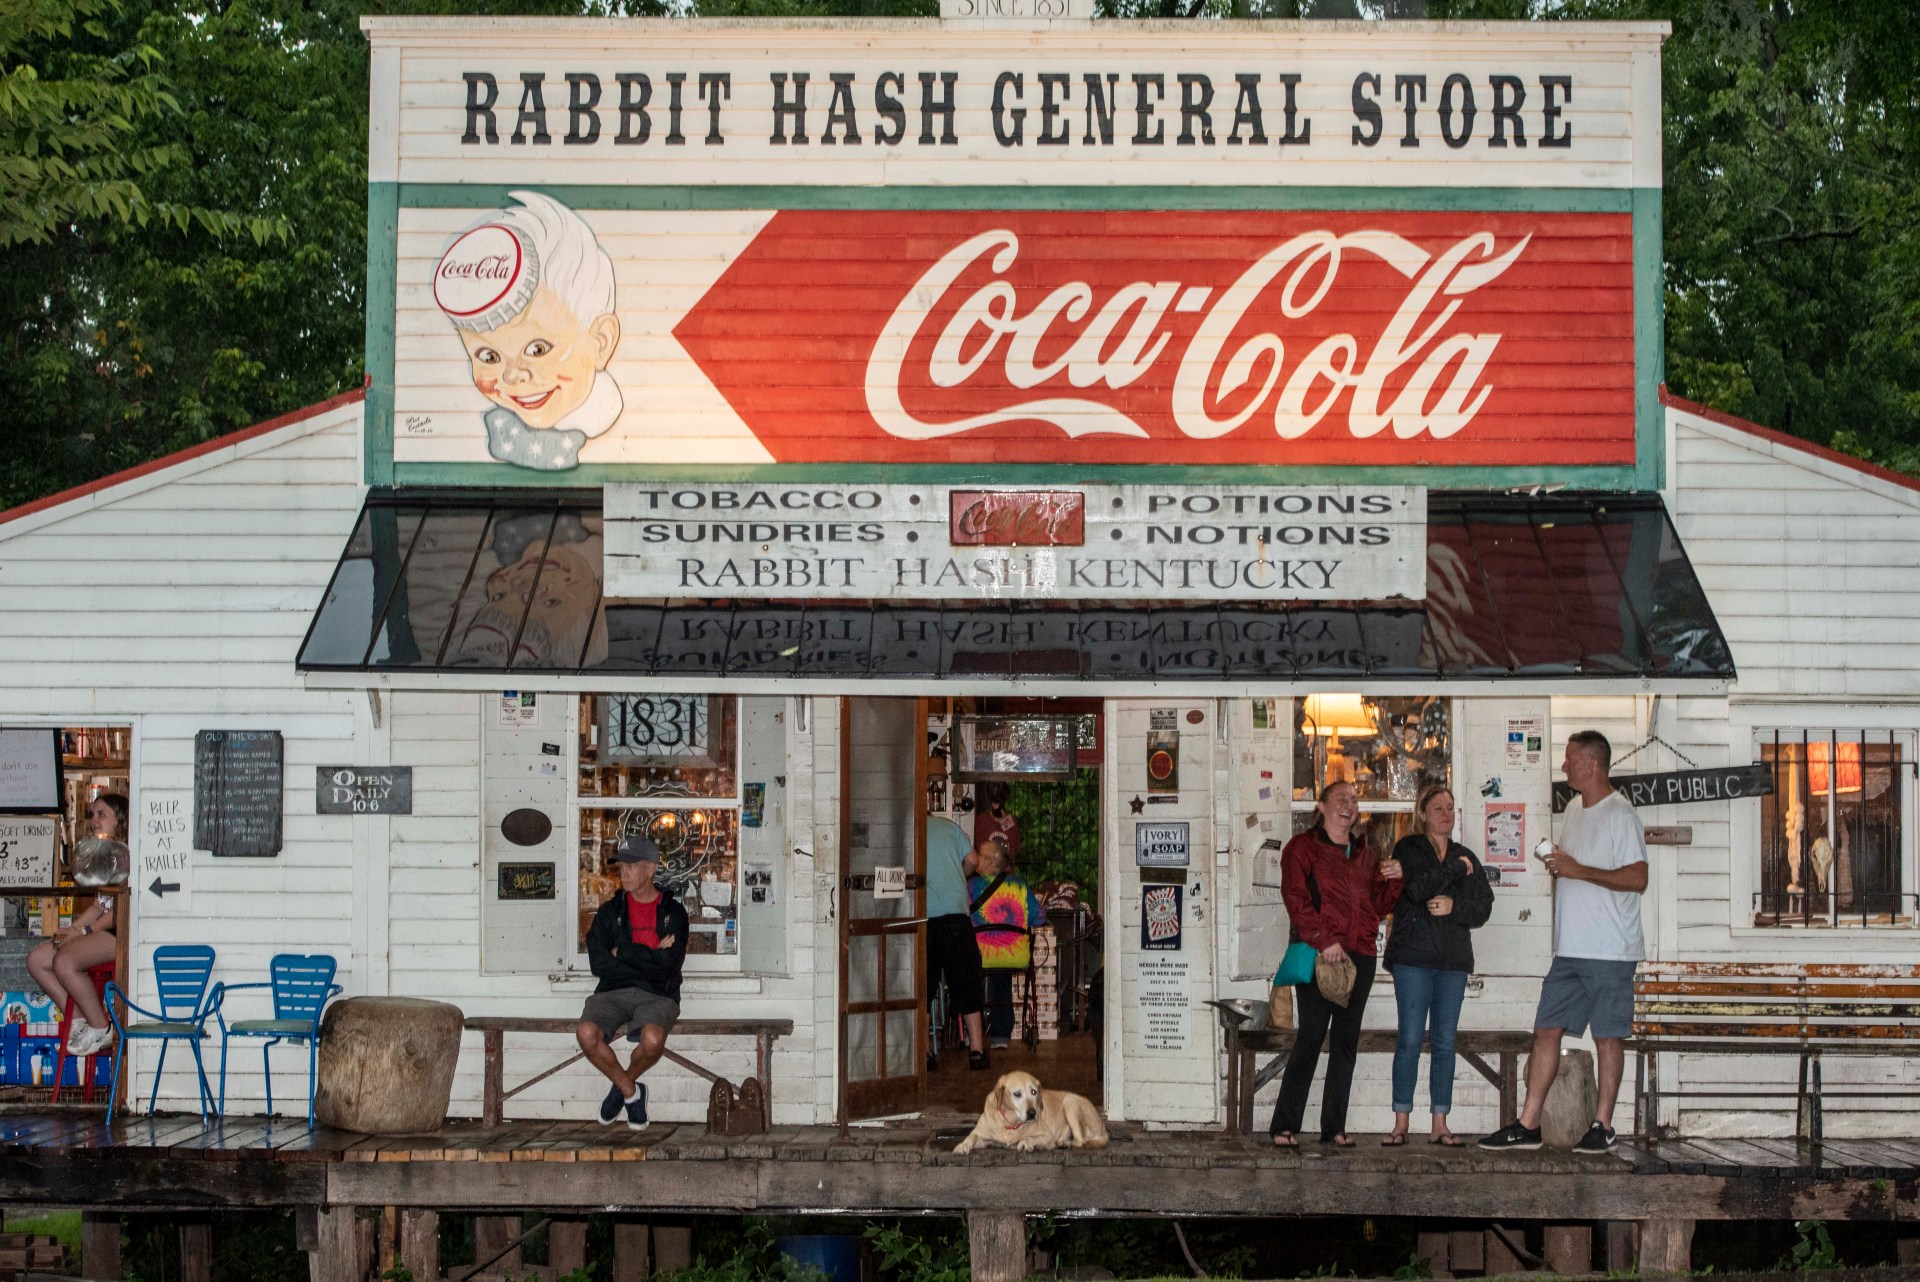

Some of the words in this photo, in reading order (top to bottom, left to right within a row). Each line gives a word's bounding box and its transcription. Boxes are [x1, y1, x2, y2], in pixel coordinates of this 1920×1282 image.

[461, 72, 731, 146] RABBIT
[769, 72, 959, 146] HASH
[991, 72, 1311, 146] GENERAL
[1352, 73, 1572, 148] STORE
[865, 229, 1533, 439] Coca-Cola
[639, 490, 882, 510] TOBACCO
[1148, 495, 1393, 514] POTIONS
[642, 523, 885, 543] SUNDRIES
[1147, 526, 1391, 546] NOTIONS
[677, 558, 865, 588] RABBIT
[1067, 558, 1342, 589] KENTUCKY
[619, 698, 697, 747] 1831
[1667, 776, 1741, 802] PUBLIC
[150, 800, 180, 815] BEER
[24, 825, 53, 837] DRINKS
[148, 818, 185, 835] SALES
[158, 836, 174, 851] AT
[1154, 844, 1182, 853] SOAP
[145, 853, 189, 872] TRAILER
